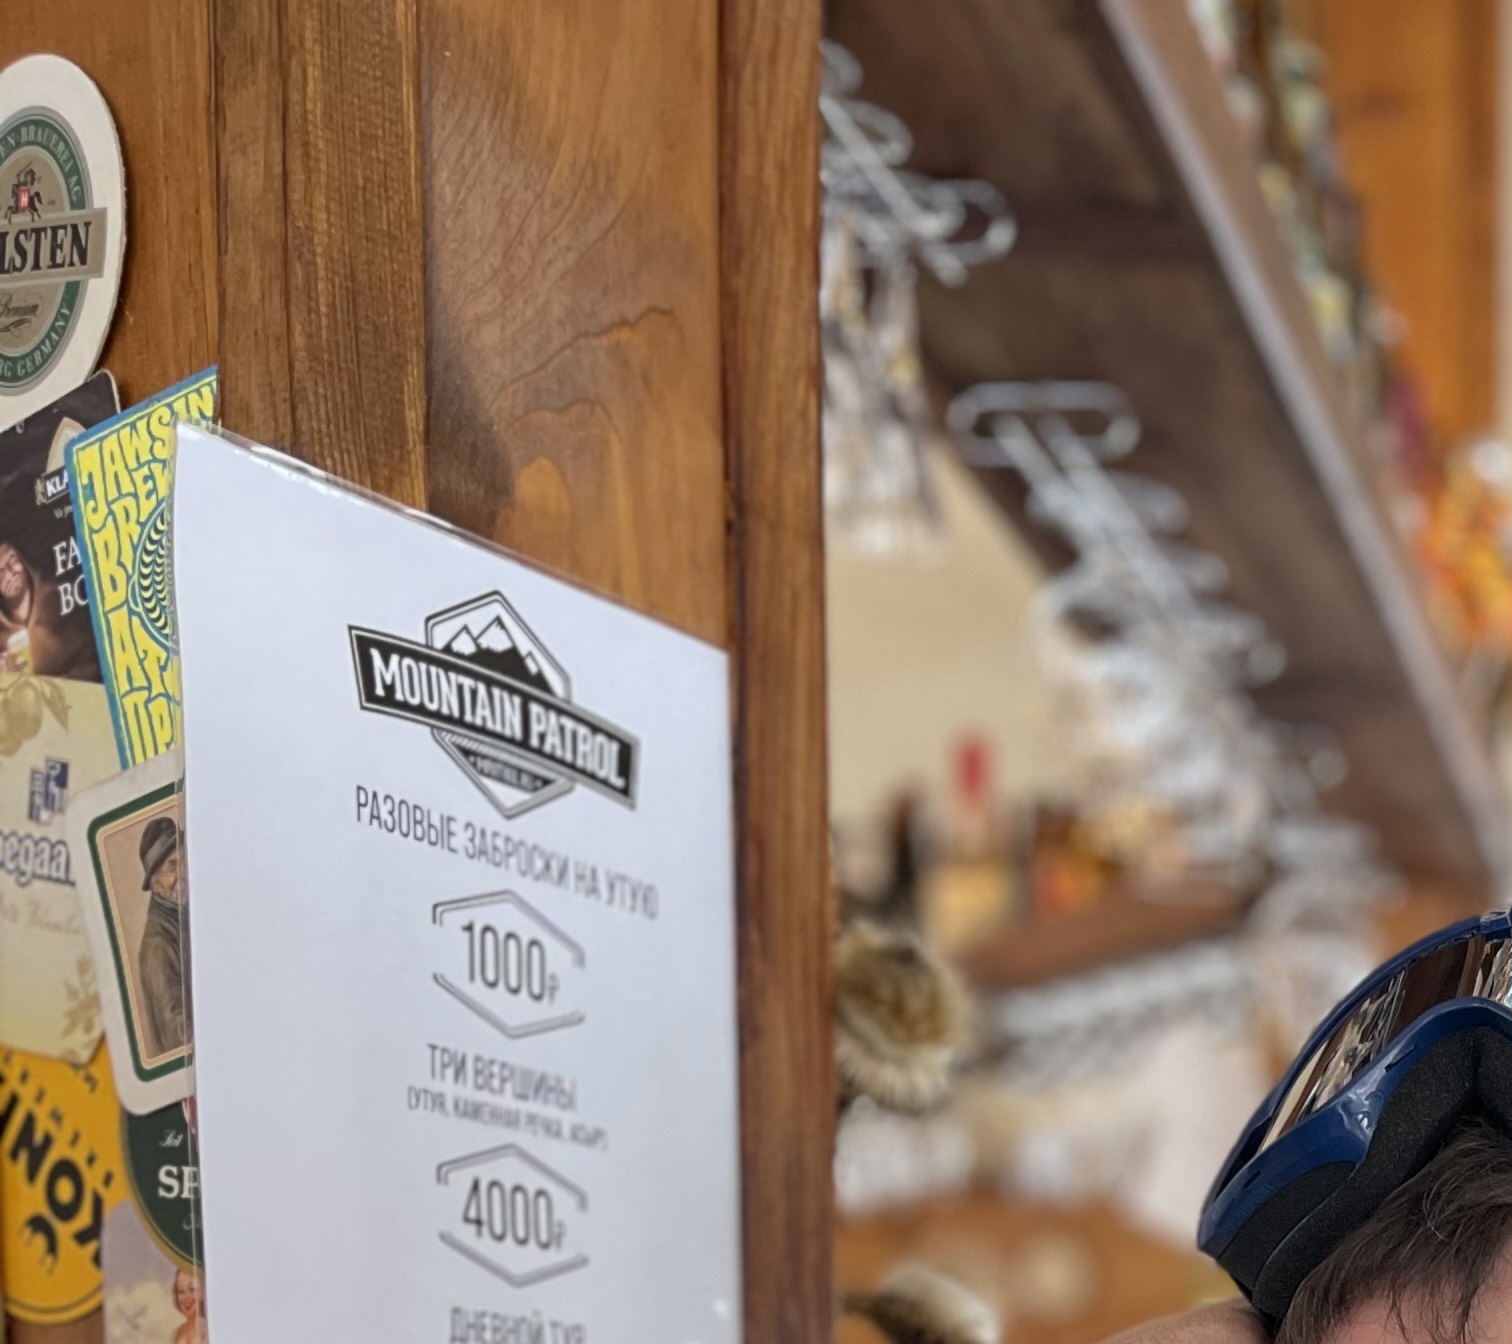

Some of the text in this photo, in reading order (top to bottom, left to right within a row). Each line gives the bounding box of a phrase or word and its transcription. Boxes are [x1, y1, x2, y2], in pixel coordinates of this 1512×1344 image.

[21, 124, 75, 172] BRAUEREI
[17, 303, 71, 377] GERMANY
[369, 646, 525, 743] MOUNTAIN
[528, 702, 627, 793] PATROL
[355, 783, 459, 855] РАЗОВЫЕ
[463, 820, 571, 890] ЗАБРОСКИ
[574, 860, 602, 902] НА
[427, 1043, 578, 1112] ТРИ ВЕРШИНЫ
